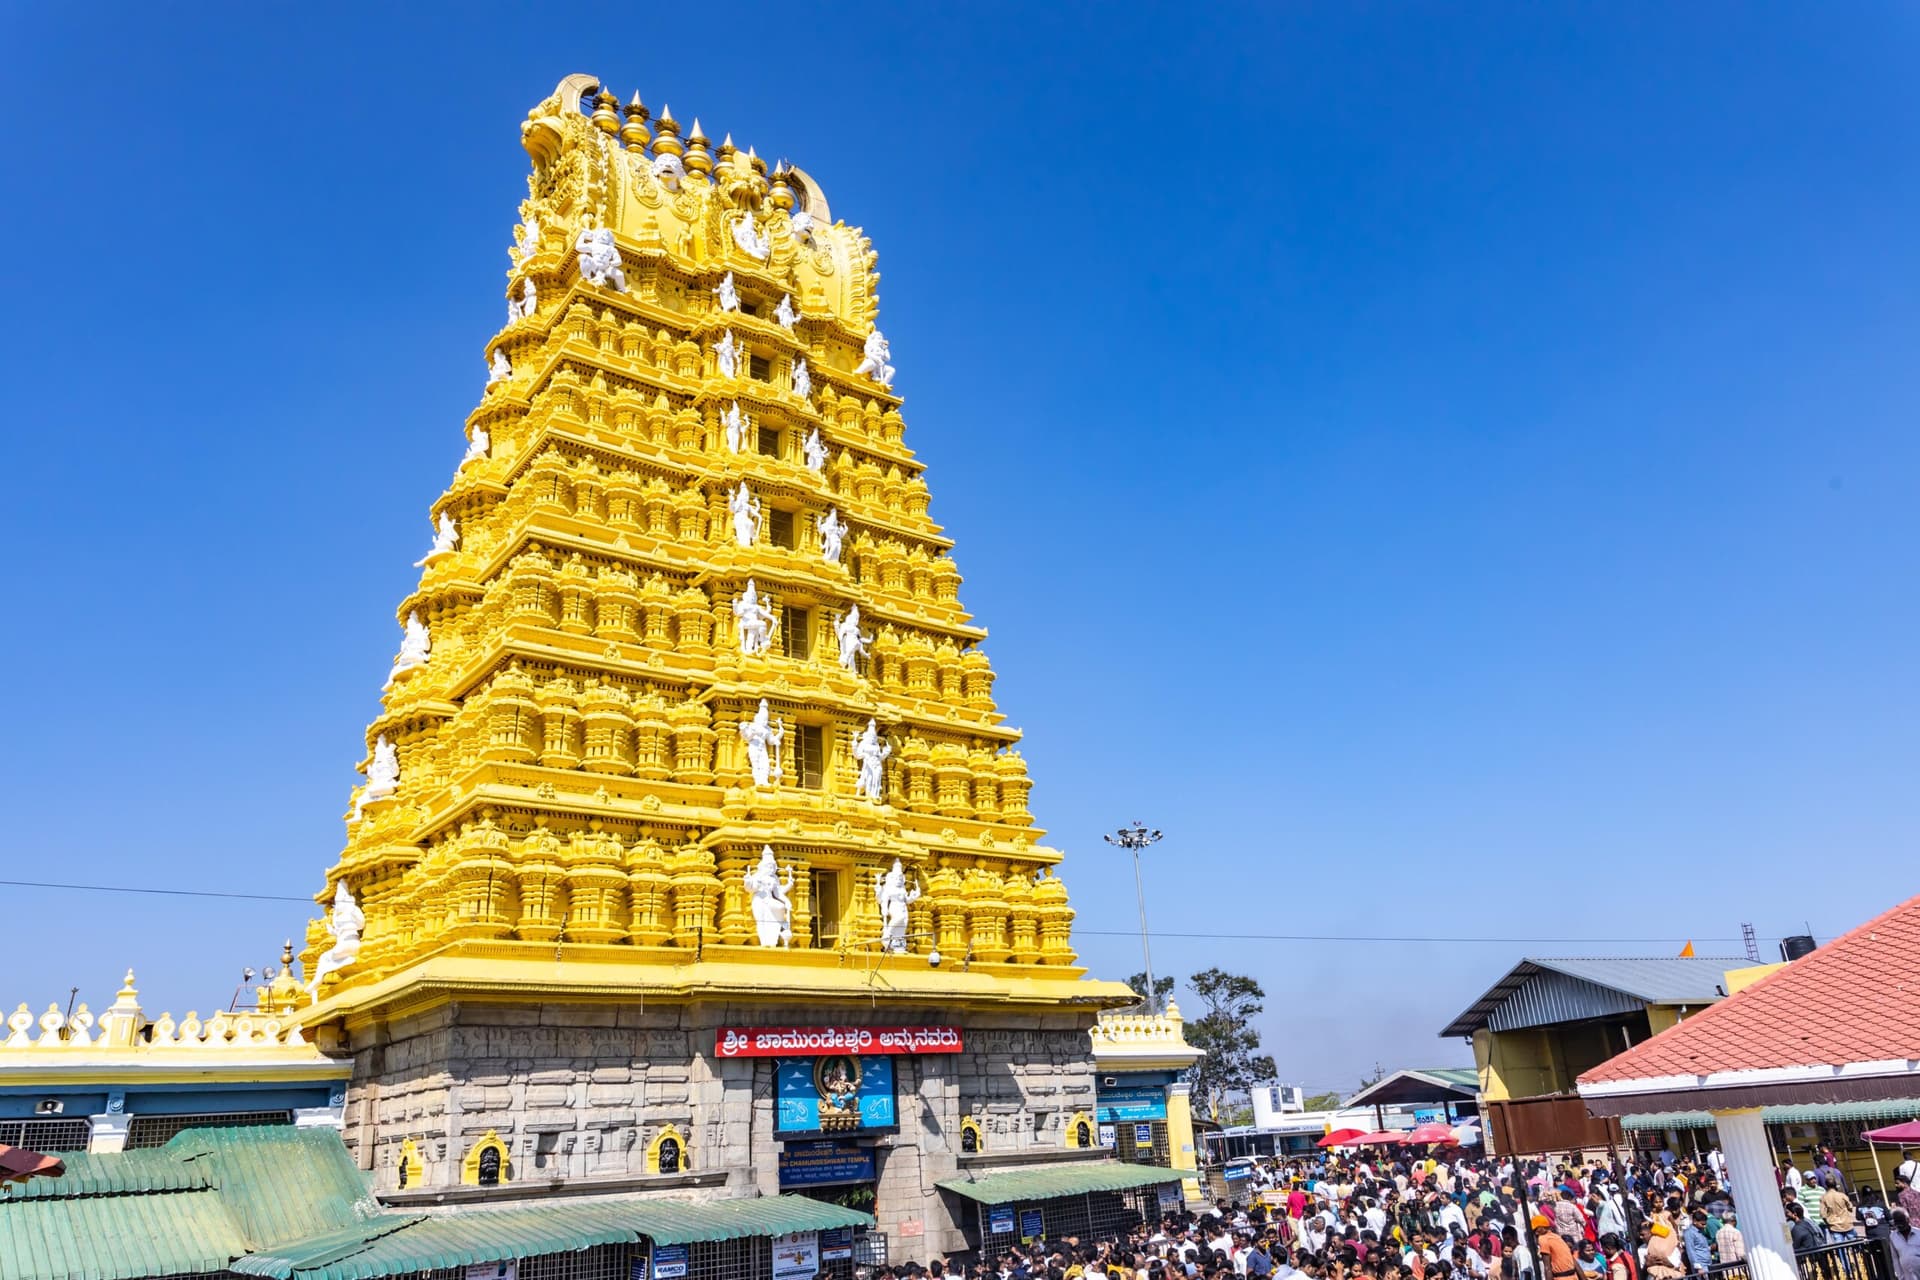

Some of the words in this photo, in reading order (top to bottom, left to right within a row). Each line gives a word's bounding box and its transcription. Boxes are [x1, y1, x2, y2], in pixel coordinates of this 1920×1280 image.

[722, 1030, 748, 1055] ಶ್ರೀ
[756, 1028, 873, 1053] ಚಾಮುಂಡೇಶ್ವರಿ
[880, 1028, 958, 1051] ಅಮ್ಮನವರು
[848, 1156, 870, 1164] TEMPLE
